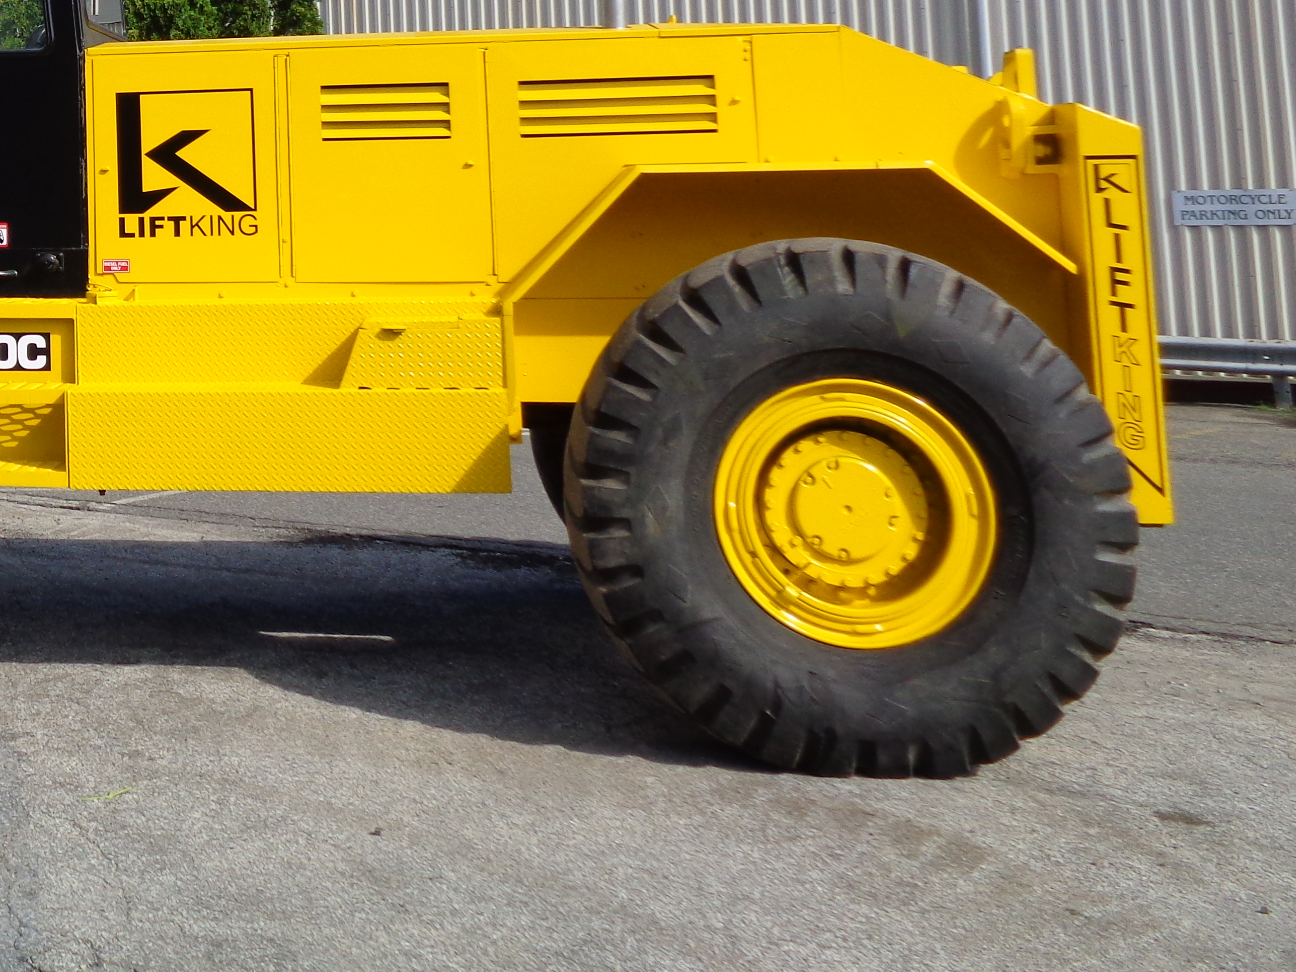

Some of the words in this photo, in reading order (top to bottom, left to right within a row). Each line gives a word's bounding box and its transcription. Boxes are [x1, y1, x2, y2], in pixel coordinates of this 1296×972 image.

[1183, 194, 1288, 205] MOTORCYCLE
[1180, 209, 1249, 221] PARKING
[1254, 208, 1294, 220] ONLY
